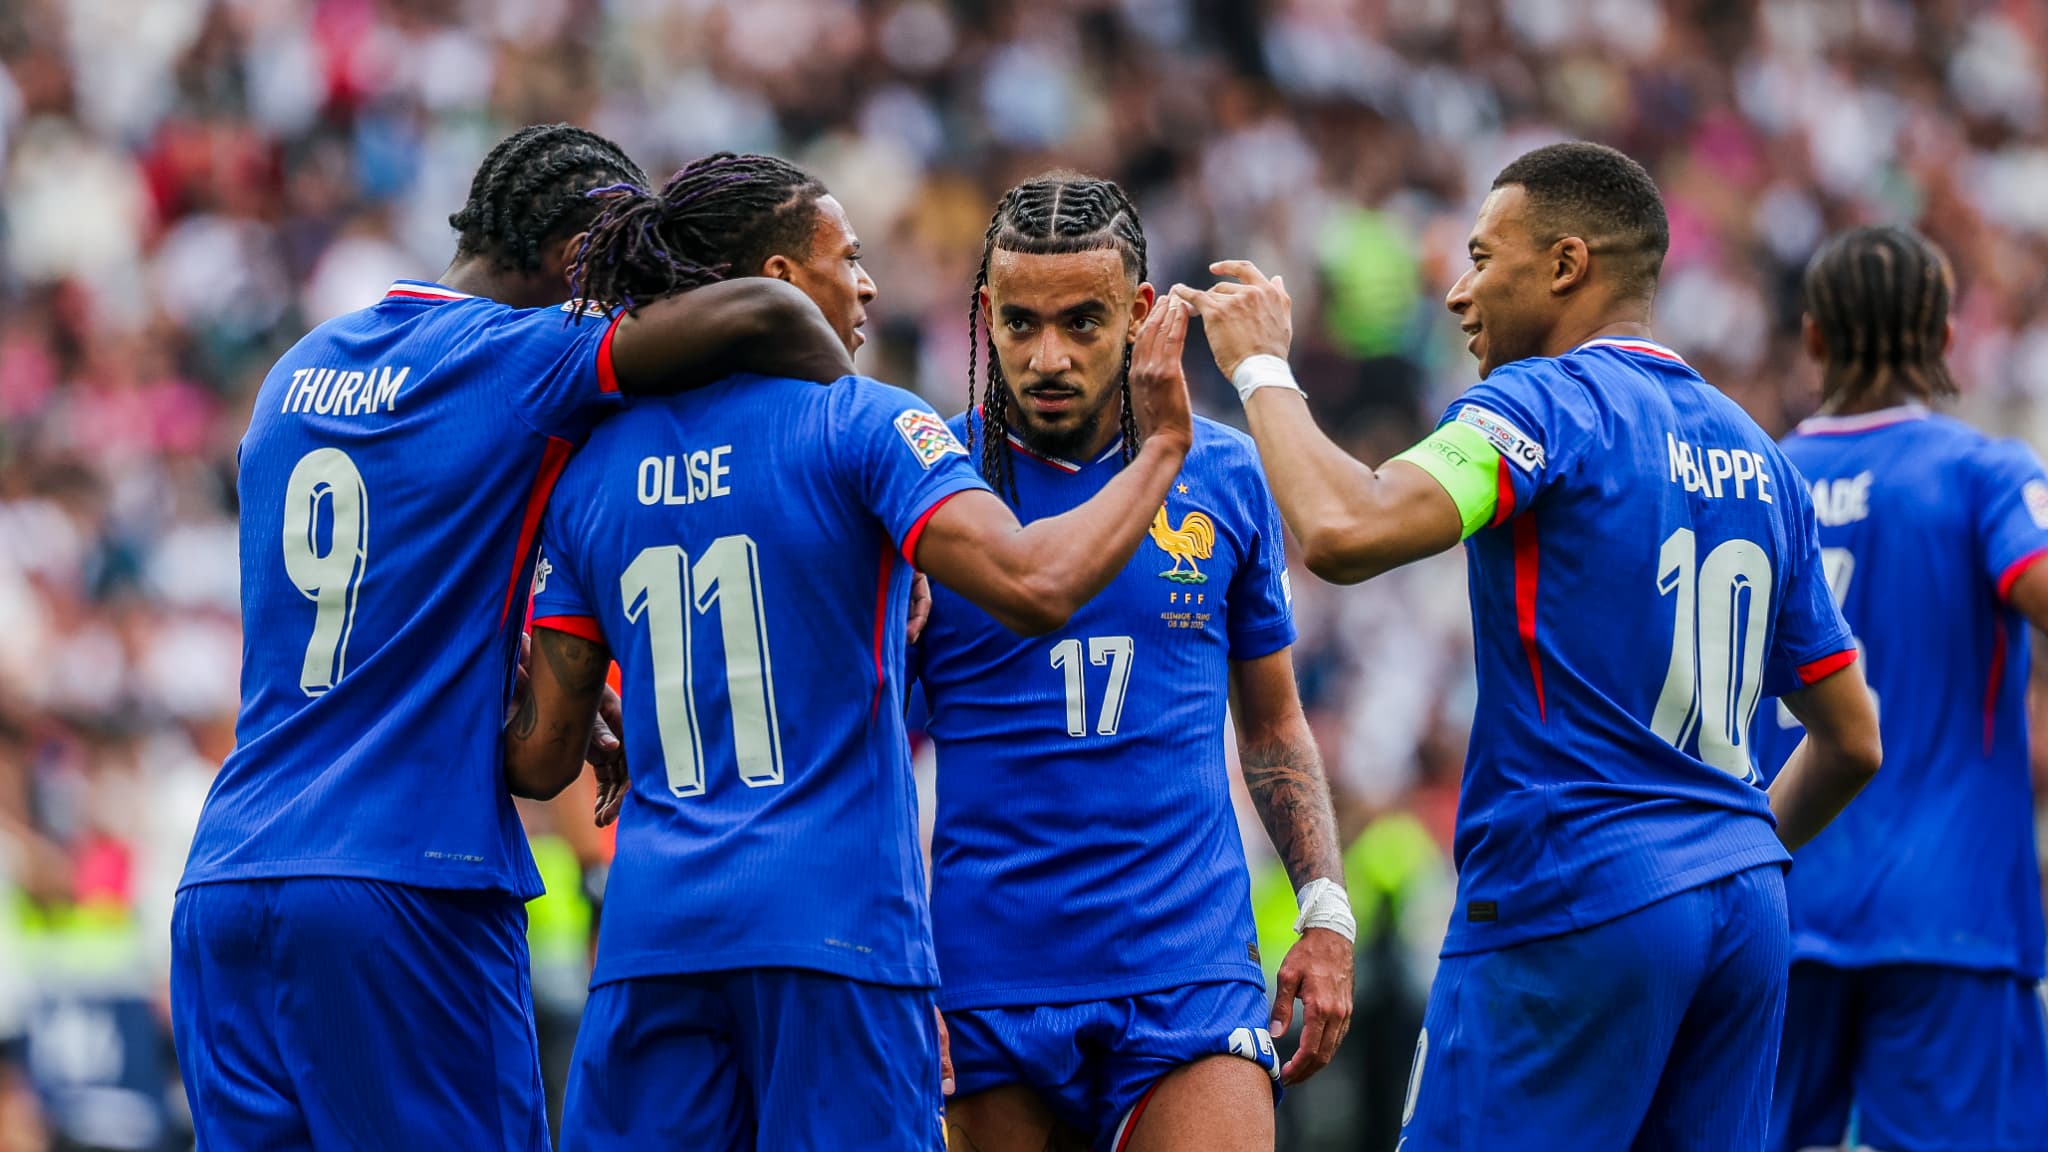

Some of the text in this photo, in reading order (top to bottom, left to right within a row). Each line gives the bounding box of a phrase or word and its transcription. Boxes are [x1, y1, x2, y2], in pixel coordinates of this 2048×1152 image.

[281, 366, 411, 416] THURAM
[637, 444, 732, 505] OLISE
[1667, 431, 1773, 505] MBAPPE
[1805, 470, 1873, 527] ADÉ
[282, 447, 369, 698] 9
[620, 534, 785, 798] 11
[1050, 636, 1134, 738] 17
[1650, 527, 1773, 786] 10
